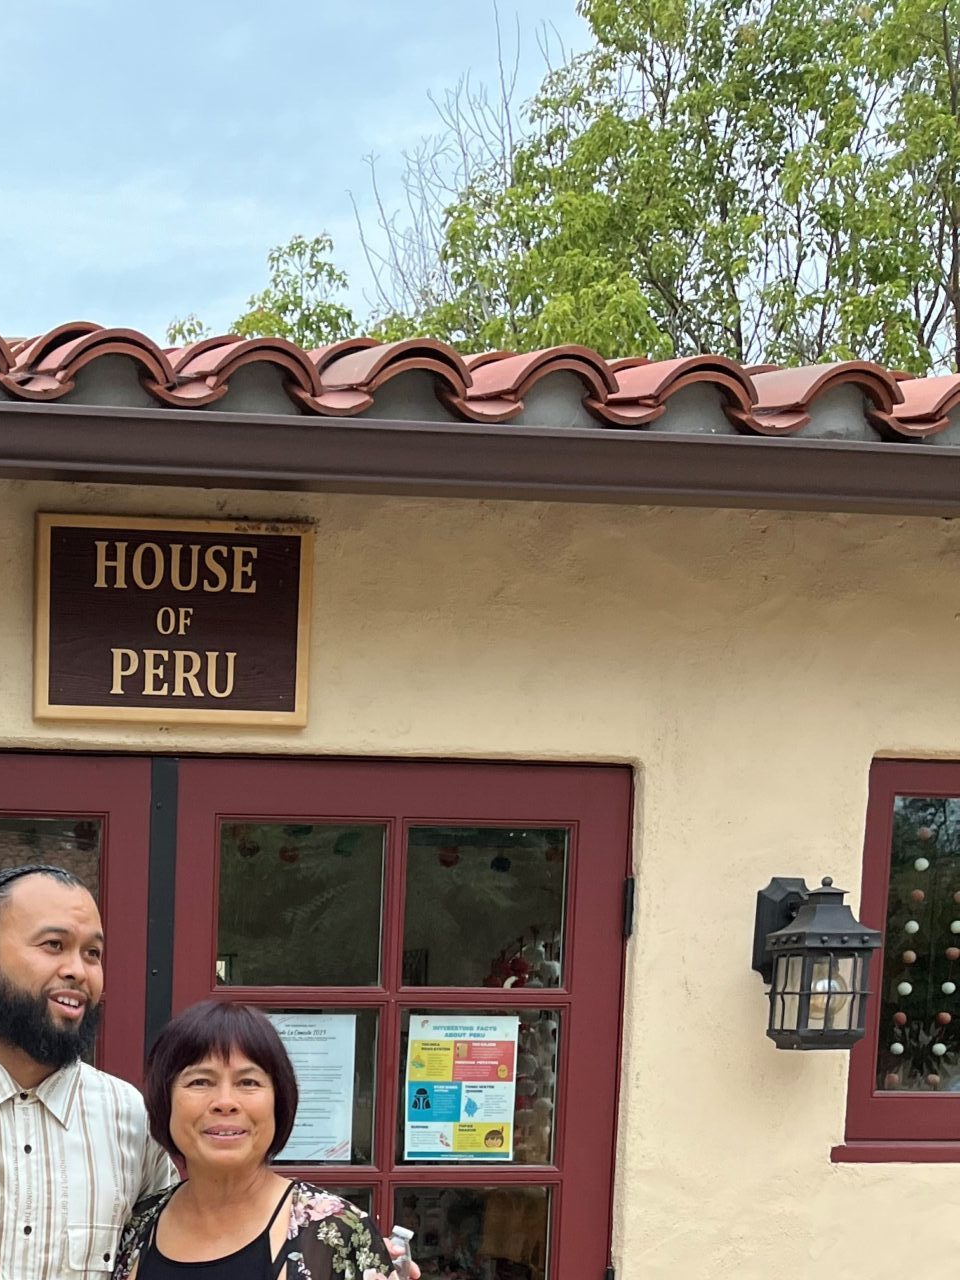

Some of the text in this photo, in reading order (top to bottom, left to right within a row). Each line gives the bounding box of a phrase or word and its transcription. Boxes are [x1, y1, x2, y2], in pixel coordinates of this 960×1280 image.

[93, 540, 258, 593] HOUSE
[156, 607, 194, 635] OF
[109, 648, 237, 698] PERU
